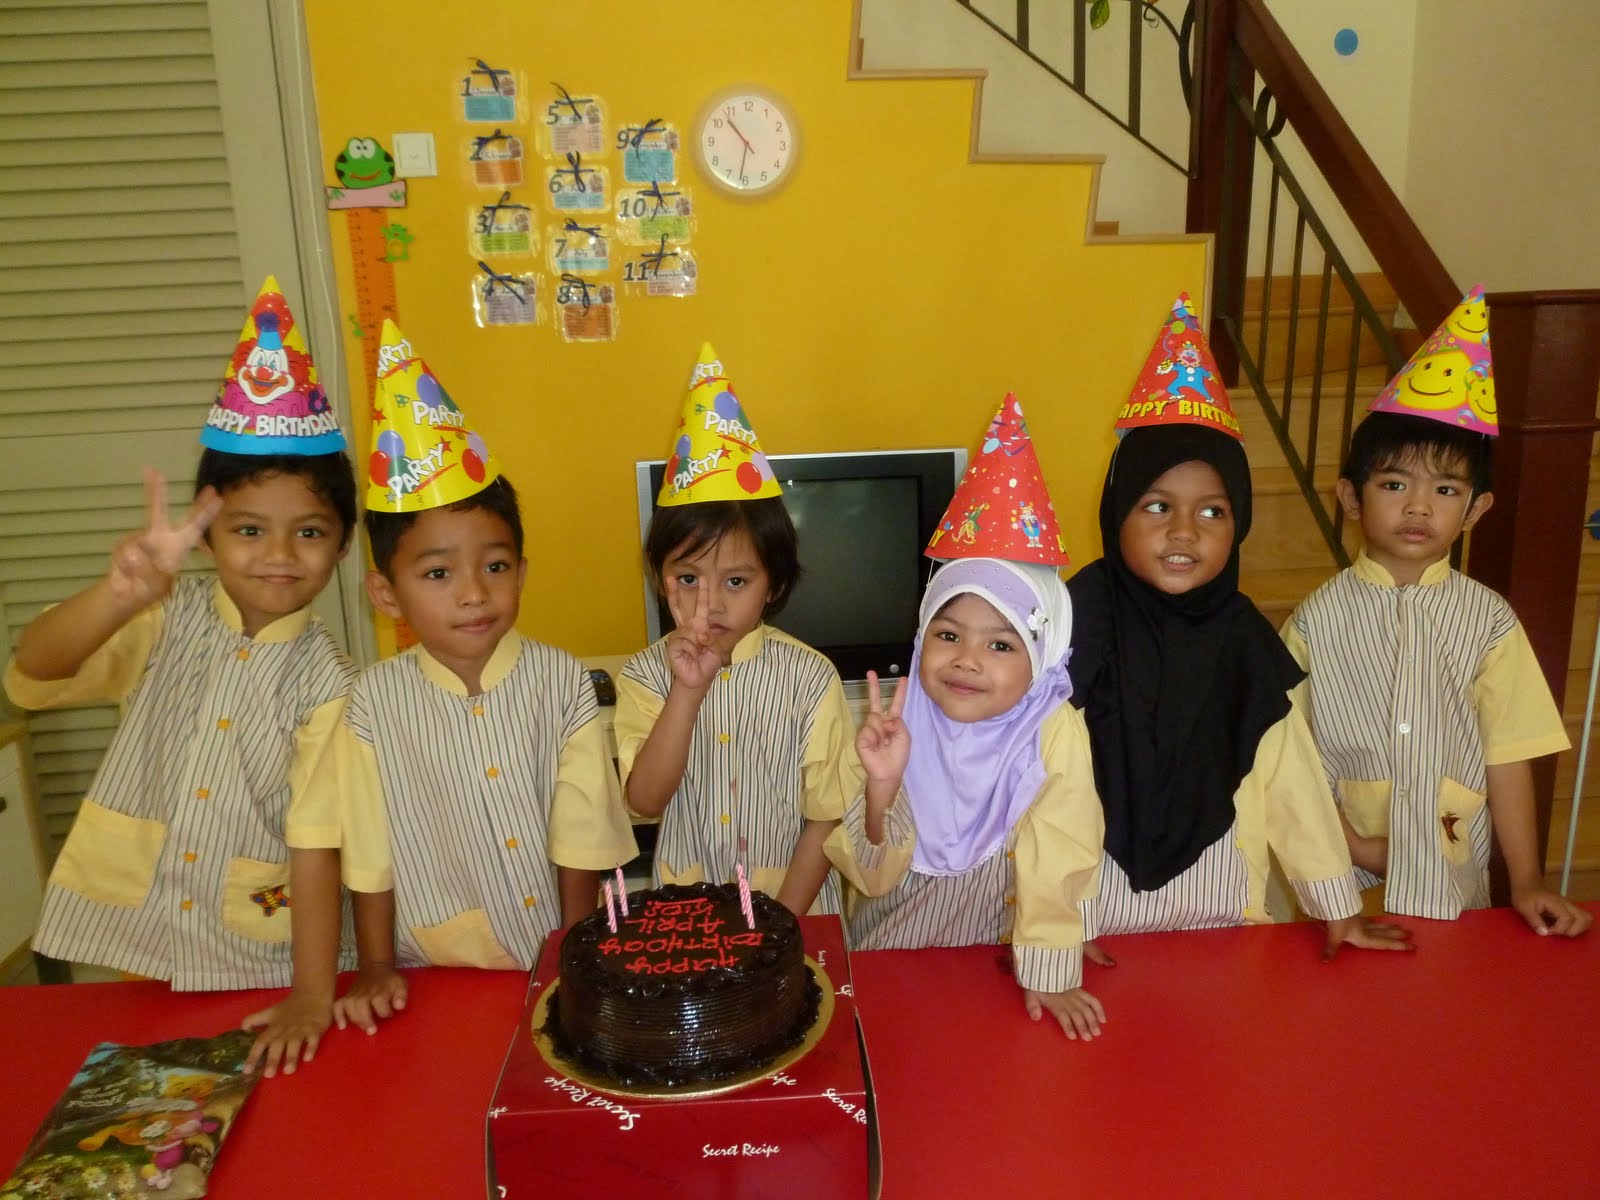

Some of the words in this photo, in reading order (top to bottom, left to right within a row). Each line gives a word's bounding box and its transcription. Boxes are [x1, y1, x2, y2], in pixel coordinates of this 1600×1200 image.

[461, 76, 472, 97] 1
[546, 104, 560, 125] 5
[726, 106, 736, 117] 11
[743, 101, 754, 112] 12
[763, 108, 769, 119] 1
[713, 118, 723, 129] 10
[775, 121, 783, 132] 2
[615, 130, 630, 150] 9
[707, 136, 715, 147] 9
[779, 140, 787, 151] 3
[711, 155, 719, 166] 8
[773, 159, 780, 170] 4
[549, 173, 563, 193] 6
[725, 169, 732, 179] 7
[741, 176, 750, 186] 6
[759, 171, 768, 182] 5
[619, 198, 647, 218] 10
[475, 214, 489, 234] 3
[554, 238, 568, 258] 7
[623, 262, 649, 281] 11
[557, 286, 570, 304] 8
[377, 338, 413, 378] ARTY
[411, 400, 465, 427] PARTY
[1118, 400, 1169, 419] APPY
[255, 411, 339, 438] BIRTHDAY
[704, 410, 758, 445] PARTY
[386, 443, 446, 500] PARTY
[672, 449, 724, 494] PARTY
[544, 1076, 592, 1102] Recipe
[822, 1088, 856, 1114] Secret
[586, 1096, 641, 1130] Secret
[702, 1144, 739, 1158] Secret
[742, 1142, 781, 1159] Recipe
